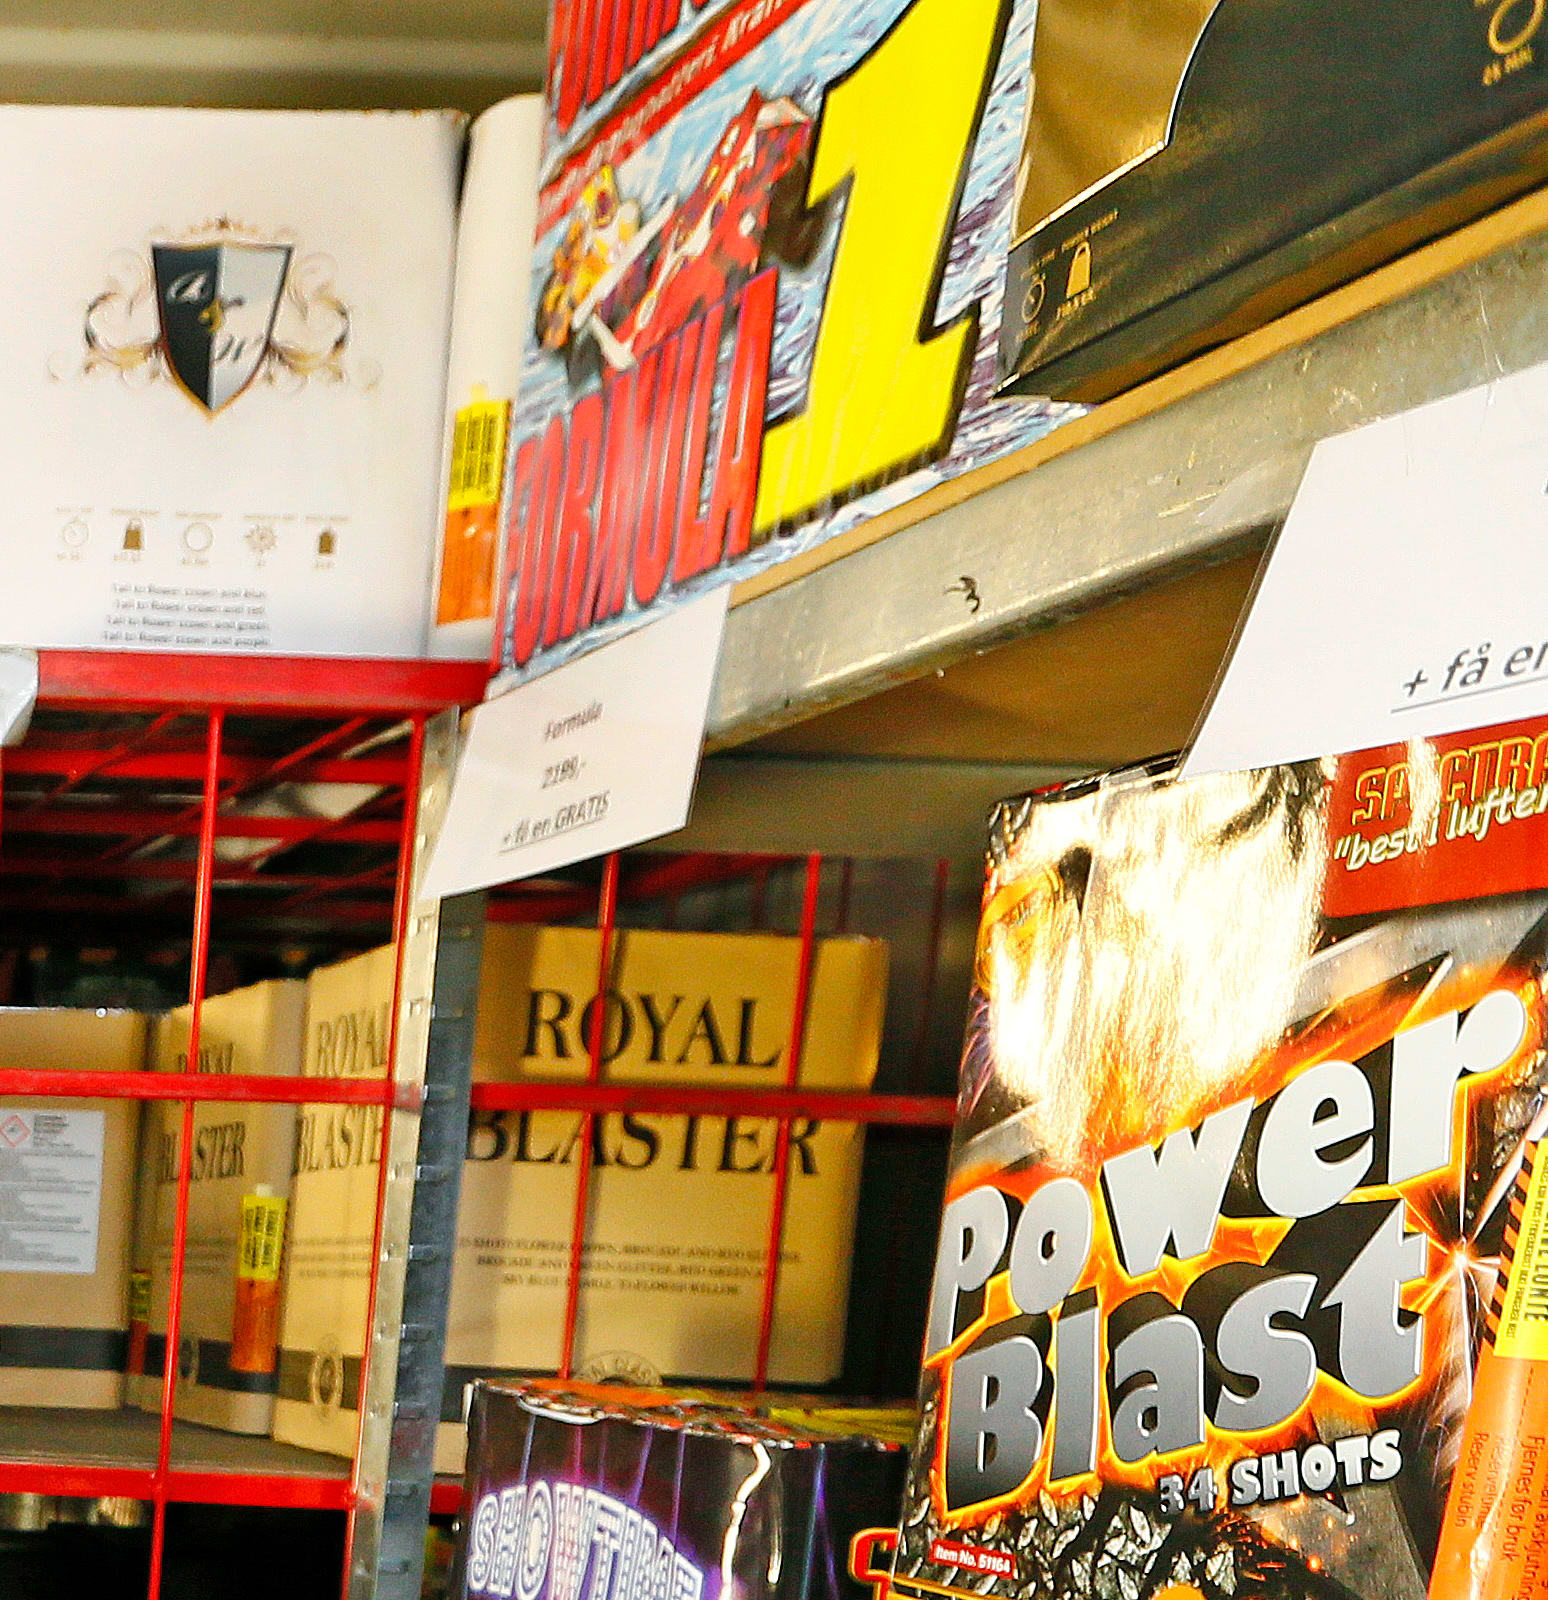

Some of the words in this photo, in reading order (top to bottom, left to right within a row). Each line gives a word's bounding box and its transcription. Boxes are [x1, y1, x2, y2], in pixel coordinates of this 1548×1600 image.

[492, 266, 780, 672] FORMULA
[1442, 642, 1492, 694] få
[544, 698, 603, 742] Formula
[554, 789, 612, 831] GRATIS
[523, 989, 782, 1068] ROYAL
[927, 988, 1527, 1360] Power
[947, 1199, 1429, 1512] Blast
[1157, 1468, 1218, 1515] 34
[1231, 1428, 1403, 1507] SHOTS
[1514, 1434, 1546, 1494] Fjernes
[935, 1544, 959, 1562] Item
[958, 1549, 977, 1567] No.
[1502, 1526, 1521, 1562] bruk
